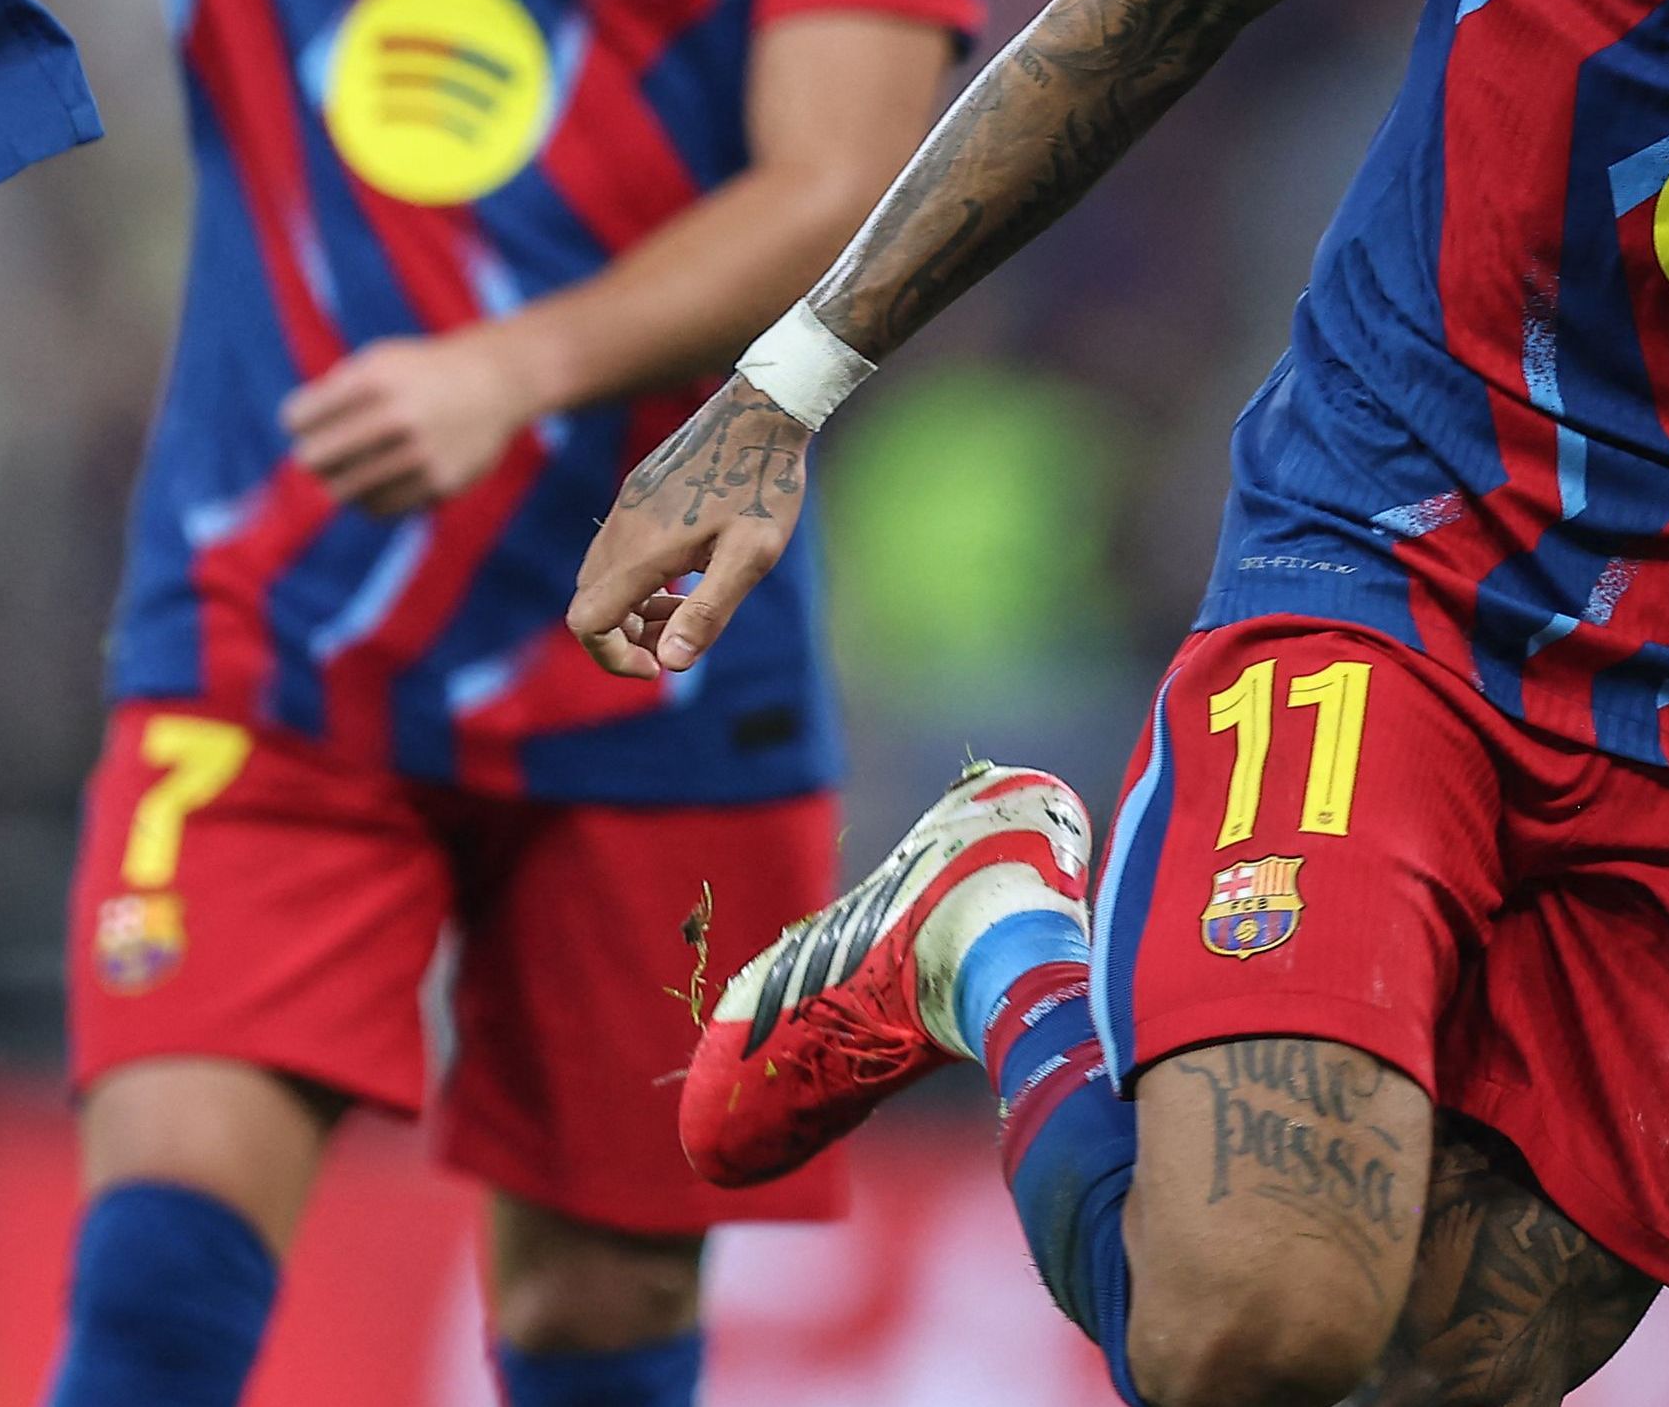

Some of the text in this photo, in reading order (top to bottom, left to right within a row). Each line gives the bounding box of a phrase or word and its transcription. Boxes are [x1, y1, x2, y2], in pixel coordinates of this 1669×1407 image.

[122, 712, 254, 889] 7
[1208, 658, 1374, 851] 11
[1230, 898, 1269, 911] FCB
